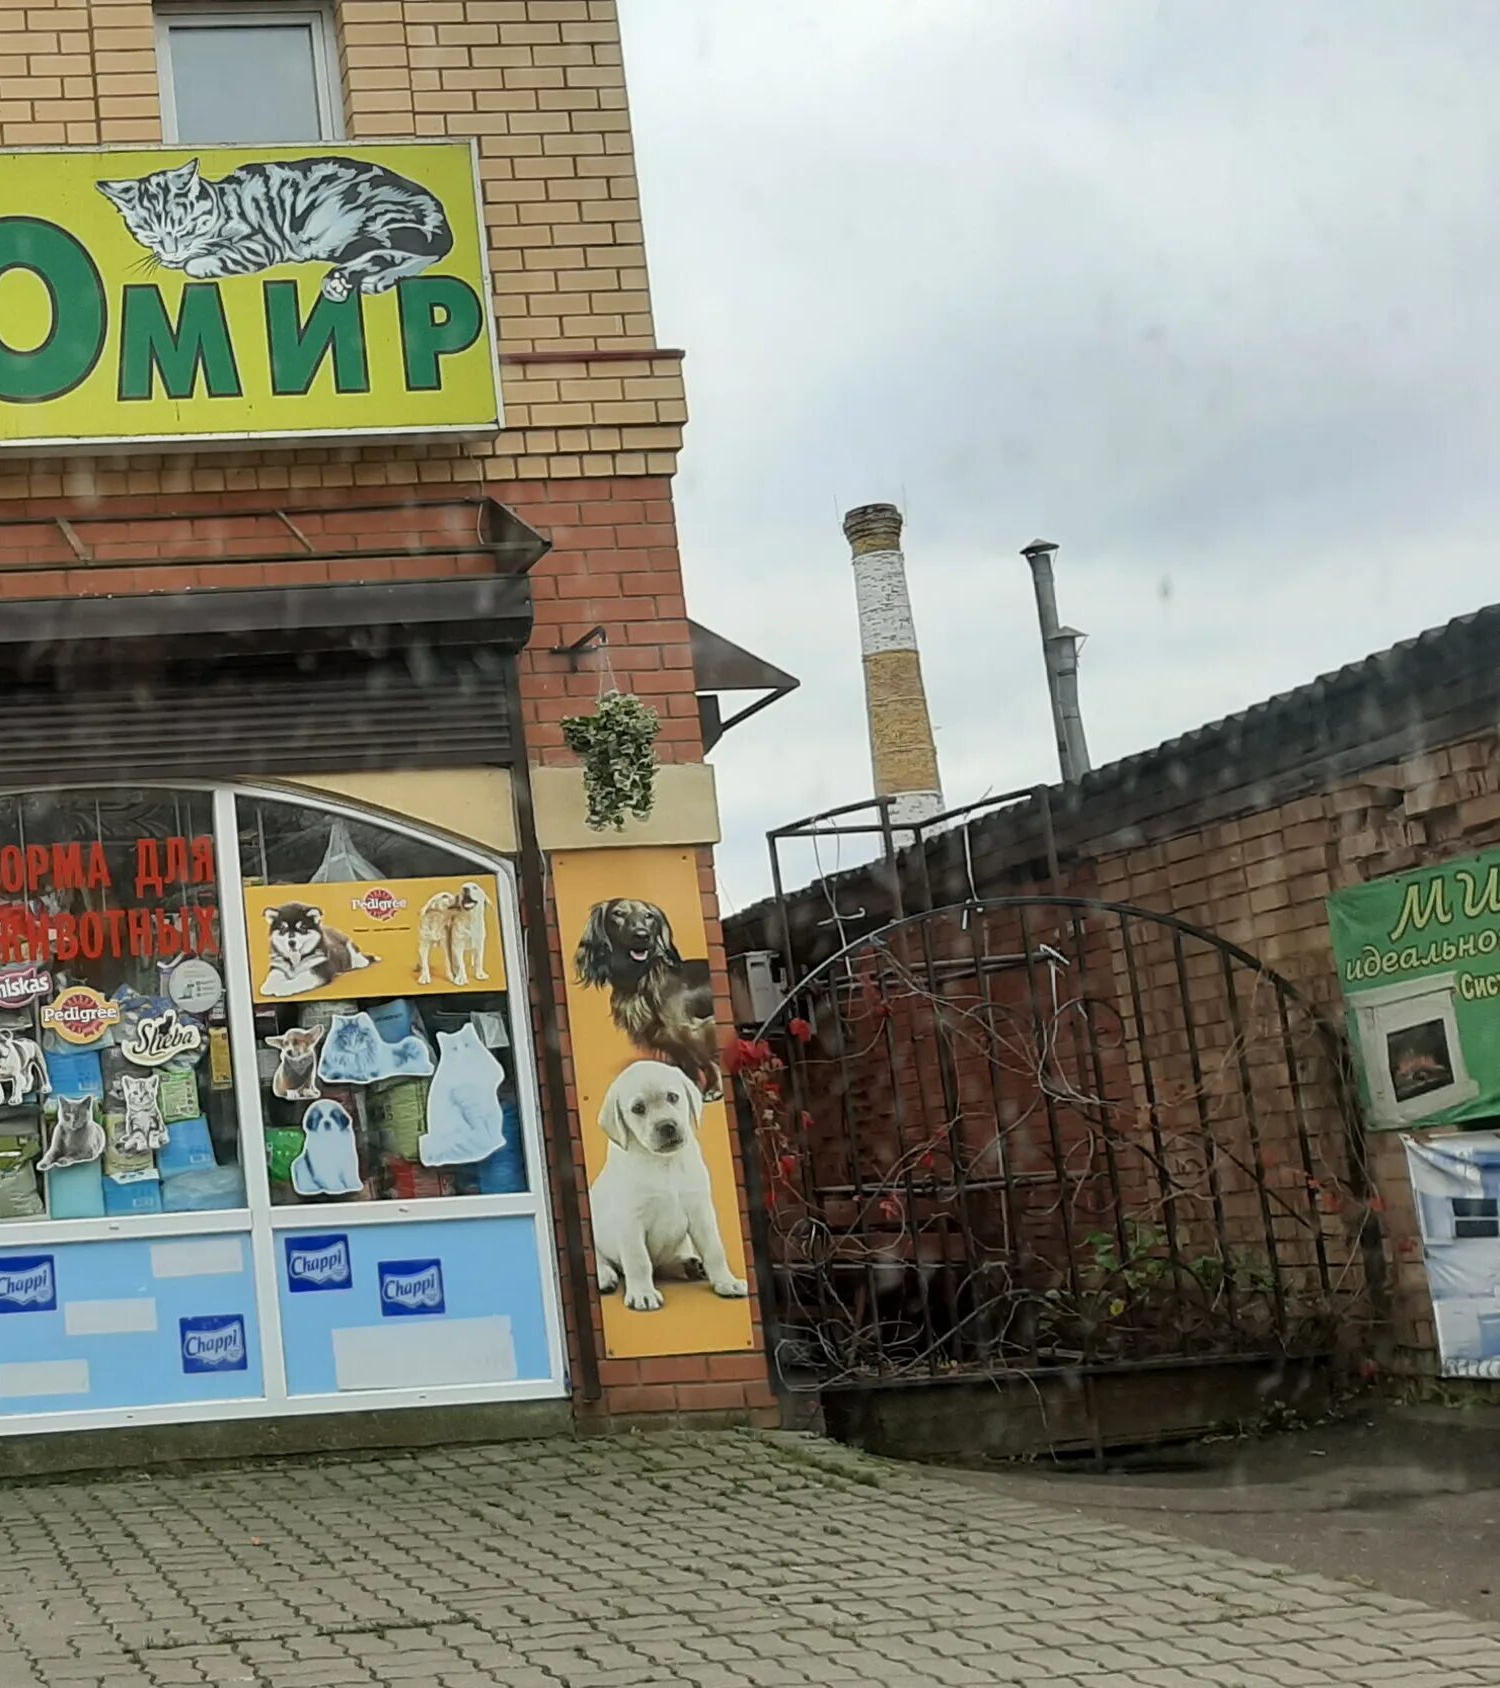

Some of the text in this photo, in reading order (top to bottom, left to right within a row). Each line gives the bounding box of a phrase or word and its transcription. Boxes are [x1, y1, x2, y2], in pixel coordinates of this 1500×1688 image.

[134, 836, 216, 899] ДЛЯ
[43, 1005, 118, 1023] Pedigree
[131, 1016, 193, 1057] Sheba
[291, 1249, 342, 1276] Chappi
[384, 1274, 435, 1300] Chappi
[183, 1329, 238, 1357] Chappi
